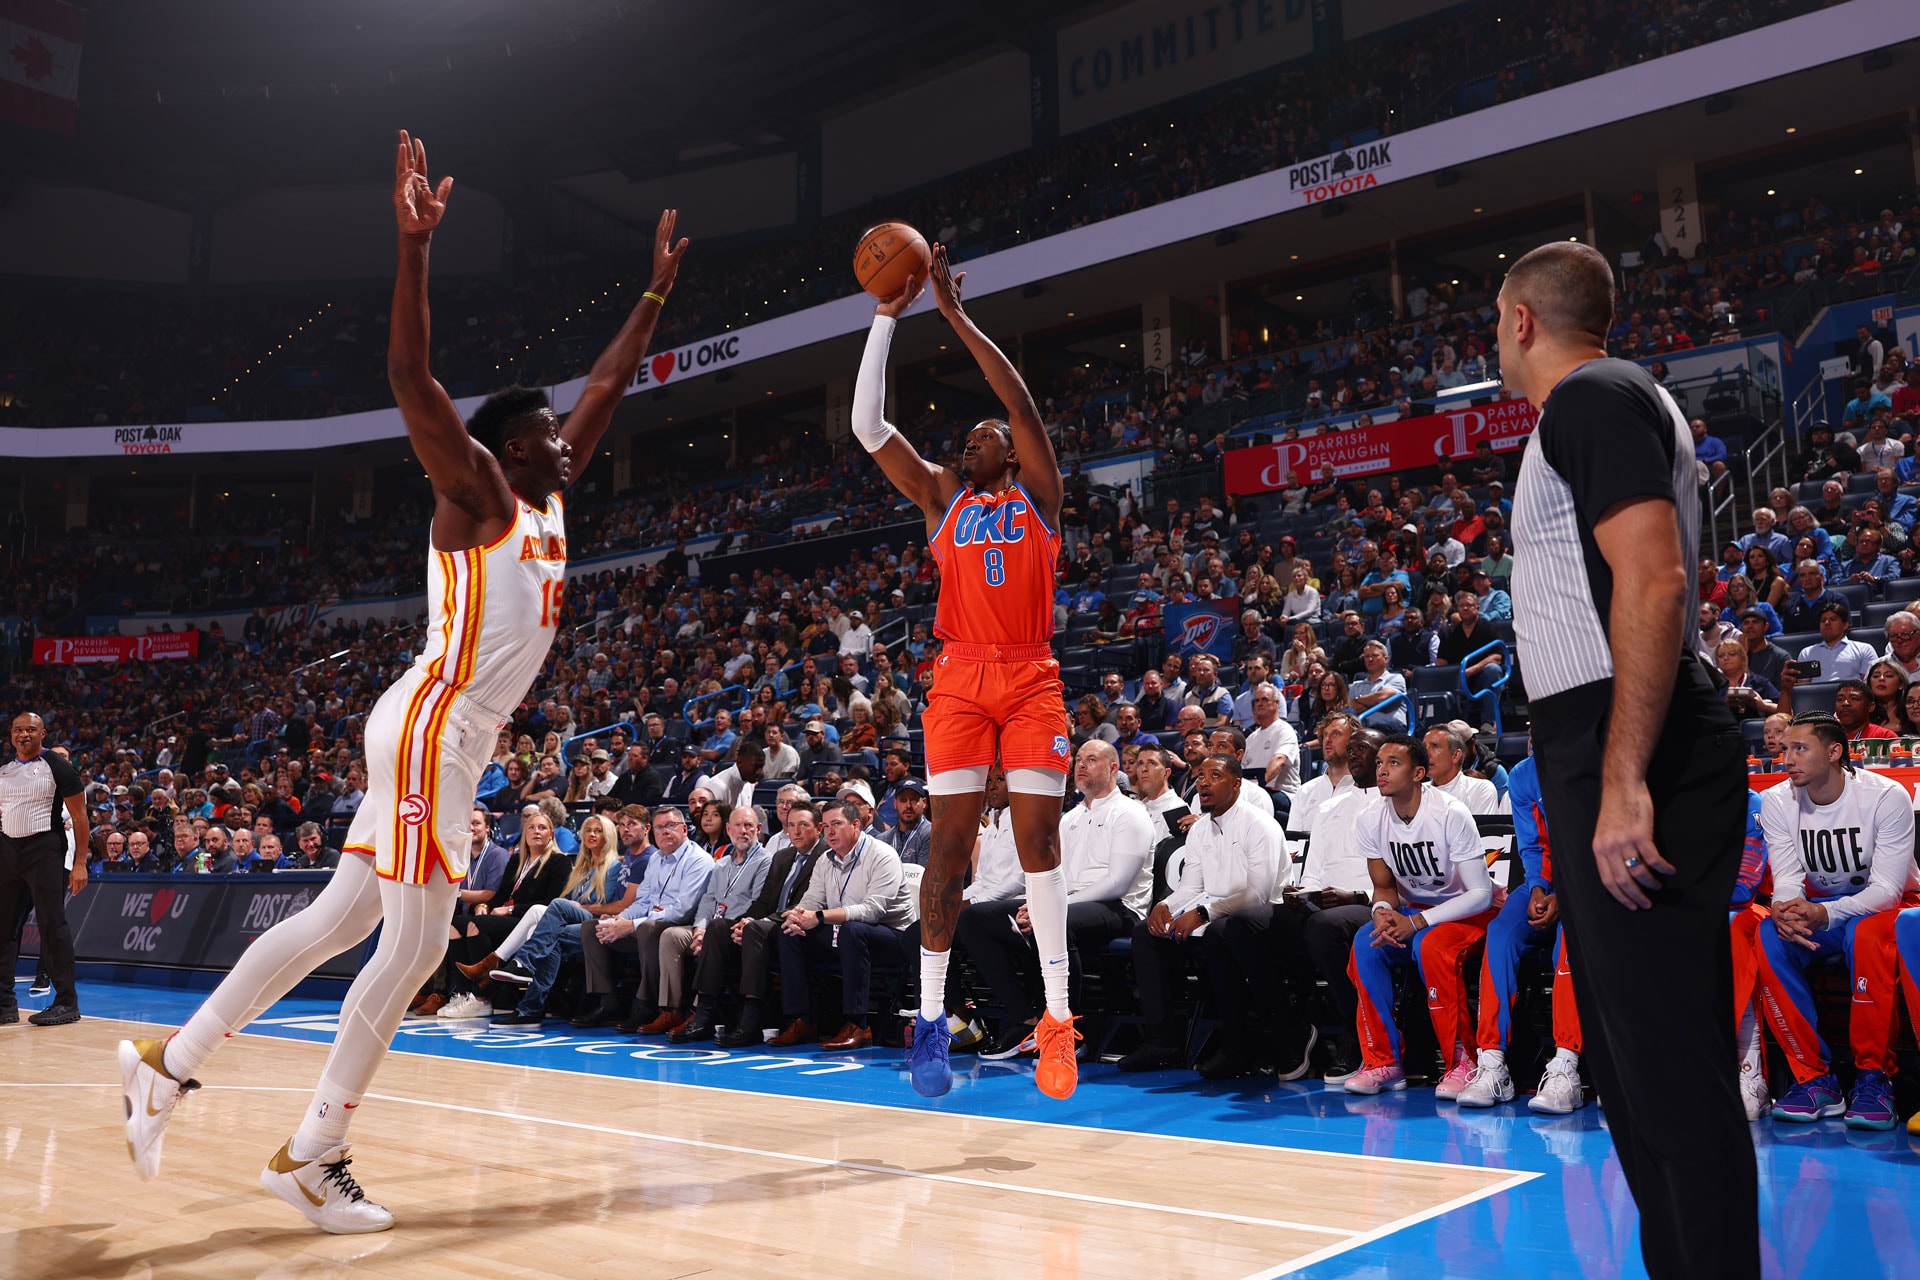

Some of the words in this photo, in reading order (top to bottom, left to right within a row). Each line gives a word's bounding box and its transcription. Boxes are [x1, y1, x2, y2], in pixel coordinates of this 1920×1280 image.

[1069, 0, 1305, 96] COMMITTED
[1290, 160, 1330, 190] POST
[1357, 142, 1391, 170] OAK
[1303, 173, 1377, 203] TOYOTA
[1672, 187, 1687, 239] 224
[1875, 307, 1890, 320] EXIT
[1153, 317, 1162, 361] 222
[678, 350, 692, 372] U
[697, 336, 739, 366] OKC
[1488, 402, 1534, 421] PARRI
[1488, 416, 1538, 436] DEVA
[115, 428, 143, 443] POST
[160, 427, 182, 441] OAK
[123, 444, 171, 454] TOYOTA
[1308, 431, 1368, 451] PARRISH
[1309, 442, 1390, 466] DEVAUGHN
[954, 500, 1027, 547] OKC
[983, 548, 1005, 587] 8
[540, 578, 564, 628] 15
[74, 639, 109, 647] PARRISH
[1183, 619, 1212, 647] OKC
[74, 647, 120, 655] DEVAUGHN
[1389, 841, 1445, 877] VOTE
[1800, 827, 1868, 873] VOTE
[121, 893, 154, 918] WE
[170, 894, 190, 919] U
[242, 893, 292, 929] POST
[123, 925, 162, 952] OKC
